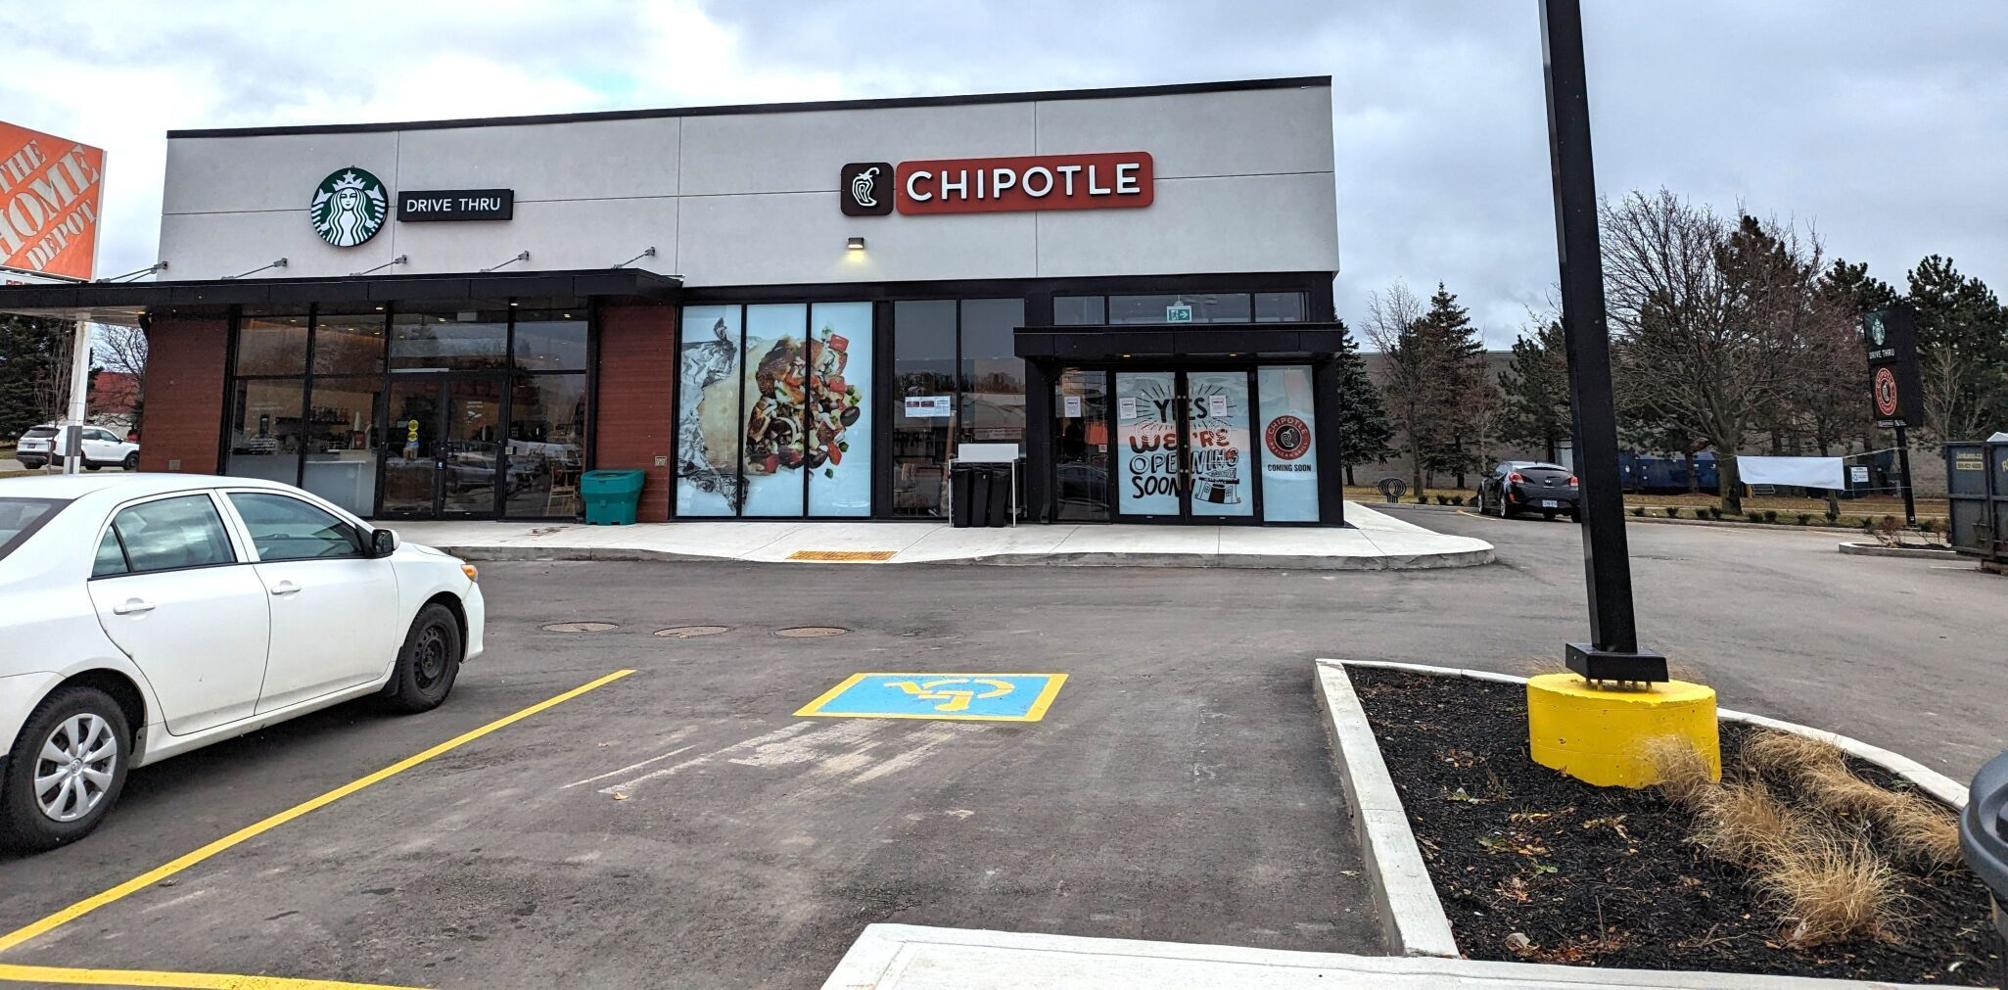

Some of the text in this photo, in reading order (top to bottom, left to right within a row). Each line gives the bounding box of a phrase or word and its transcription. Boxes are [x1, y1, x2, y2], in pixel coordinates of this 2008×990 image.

[0, 139, 47, 194] THE
[906, 162, 1141, 202] CHIPOTLE
[406, 198, 501, 213] DRIVE THRU
[26, 199, 97, 271] DEPOT
[1268, 417, 1307, 435] CHIPOTLE
[1129, 447, 1239, 475] OPENING
[1131, 475, 1196, 499] SOON
